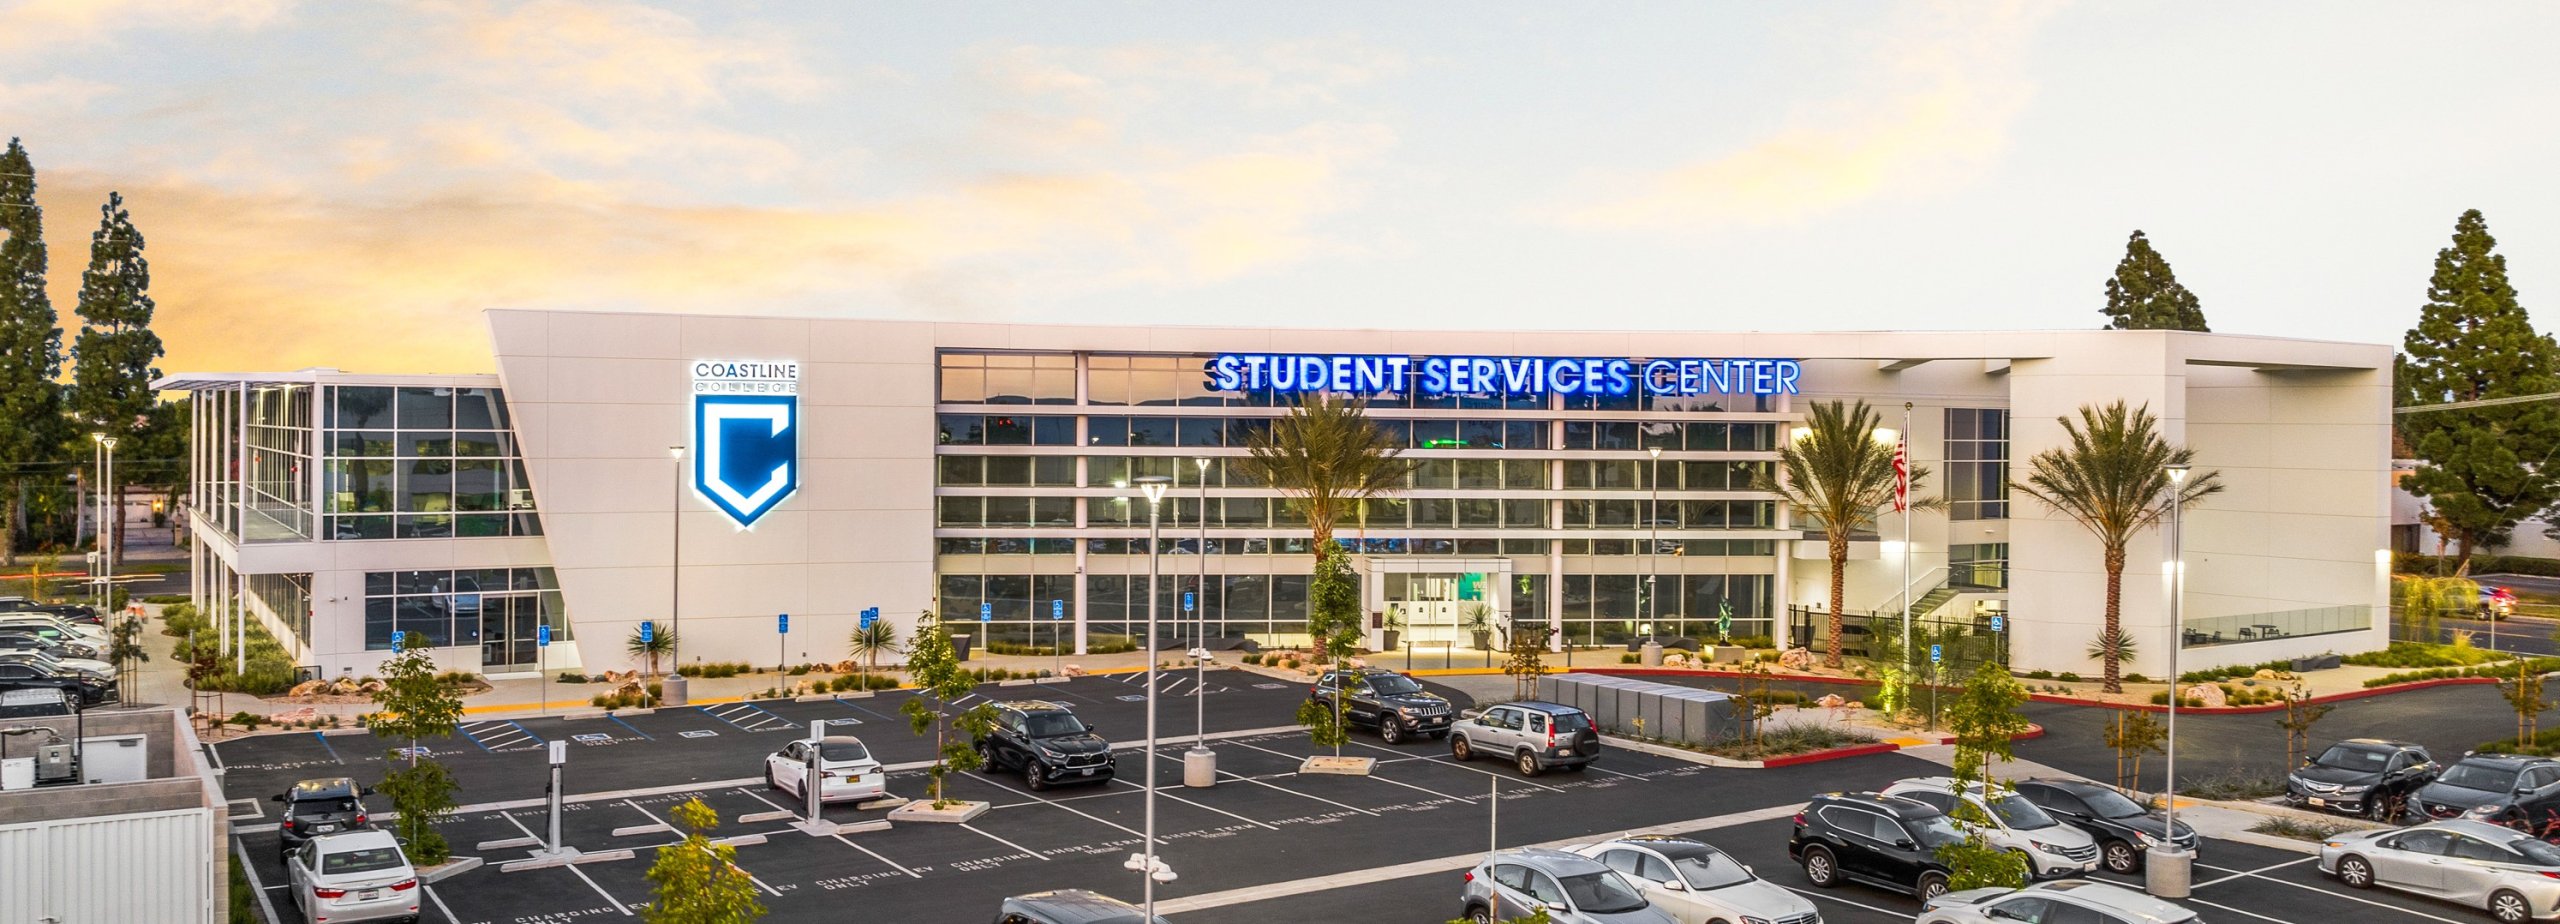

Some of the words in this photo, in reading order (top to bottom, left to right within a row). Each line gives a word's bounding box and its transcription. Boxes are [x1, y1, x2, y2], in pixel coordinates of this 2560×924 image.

[695, 362, 797, 379] COASTLINE
[1216, 355, 1408, 391] STUDENT
[1424, 358, 1631, 394] SERVICES
[1644, 360, 1800, 394] CENTER
[695, 382, 797, 393] COLLEGE
[950, 853, 1031, 868] CHARGING
[1043, 844, 1093, 856] SHORT
[959, 861, 1002, 872] ONLY
[776, 883, 799, 892] EV
[815, 871, 902, 886] CHARGING
[823, 880, 870, 890] ONLY
[514, 906, 614, 924] CHARGING
